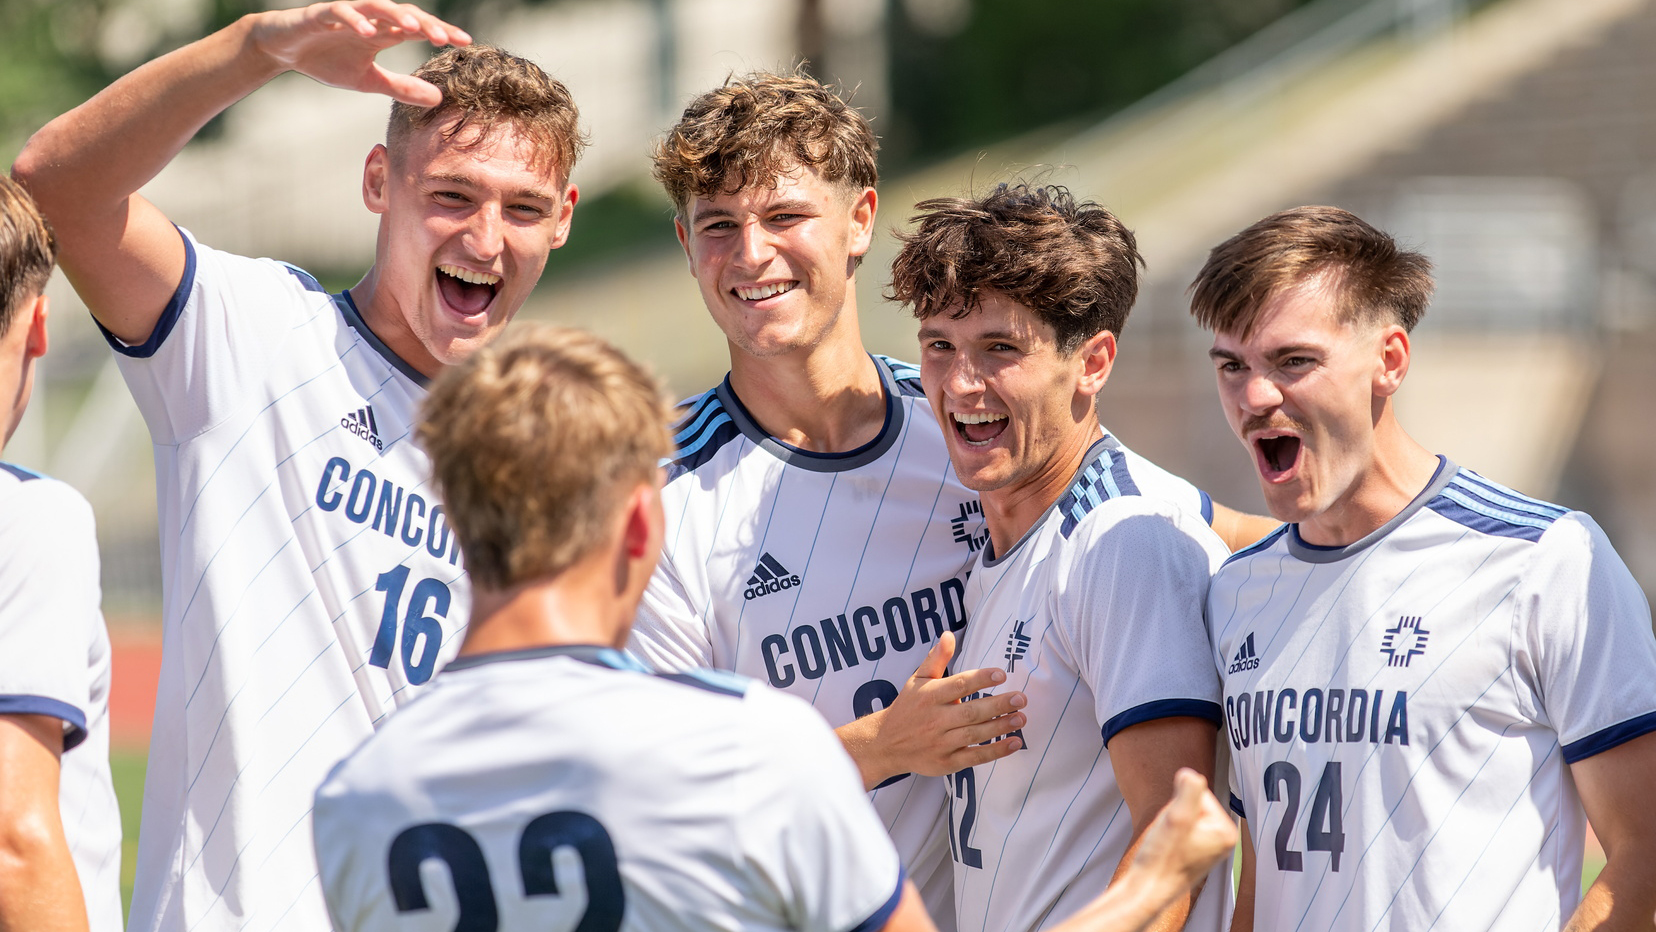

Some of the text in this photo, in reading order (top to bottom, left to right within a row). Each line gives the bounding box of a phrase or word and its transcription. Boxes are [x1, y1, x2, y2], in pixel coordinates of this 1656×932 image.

[340, 416, 383, 451] adidas
[743, 572, 801, 601] adidas
[368, 563, 452, 686] 16
[761, 570, 971, 689] CONCORD
[1228, 656, 1260, 675] adidas
[1226, 687, 1410, 751] CONCORDIA
[1263, 760, 1346, 873] 24
